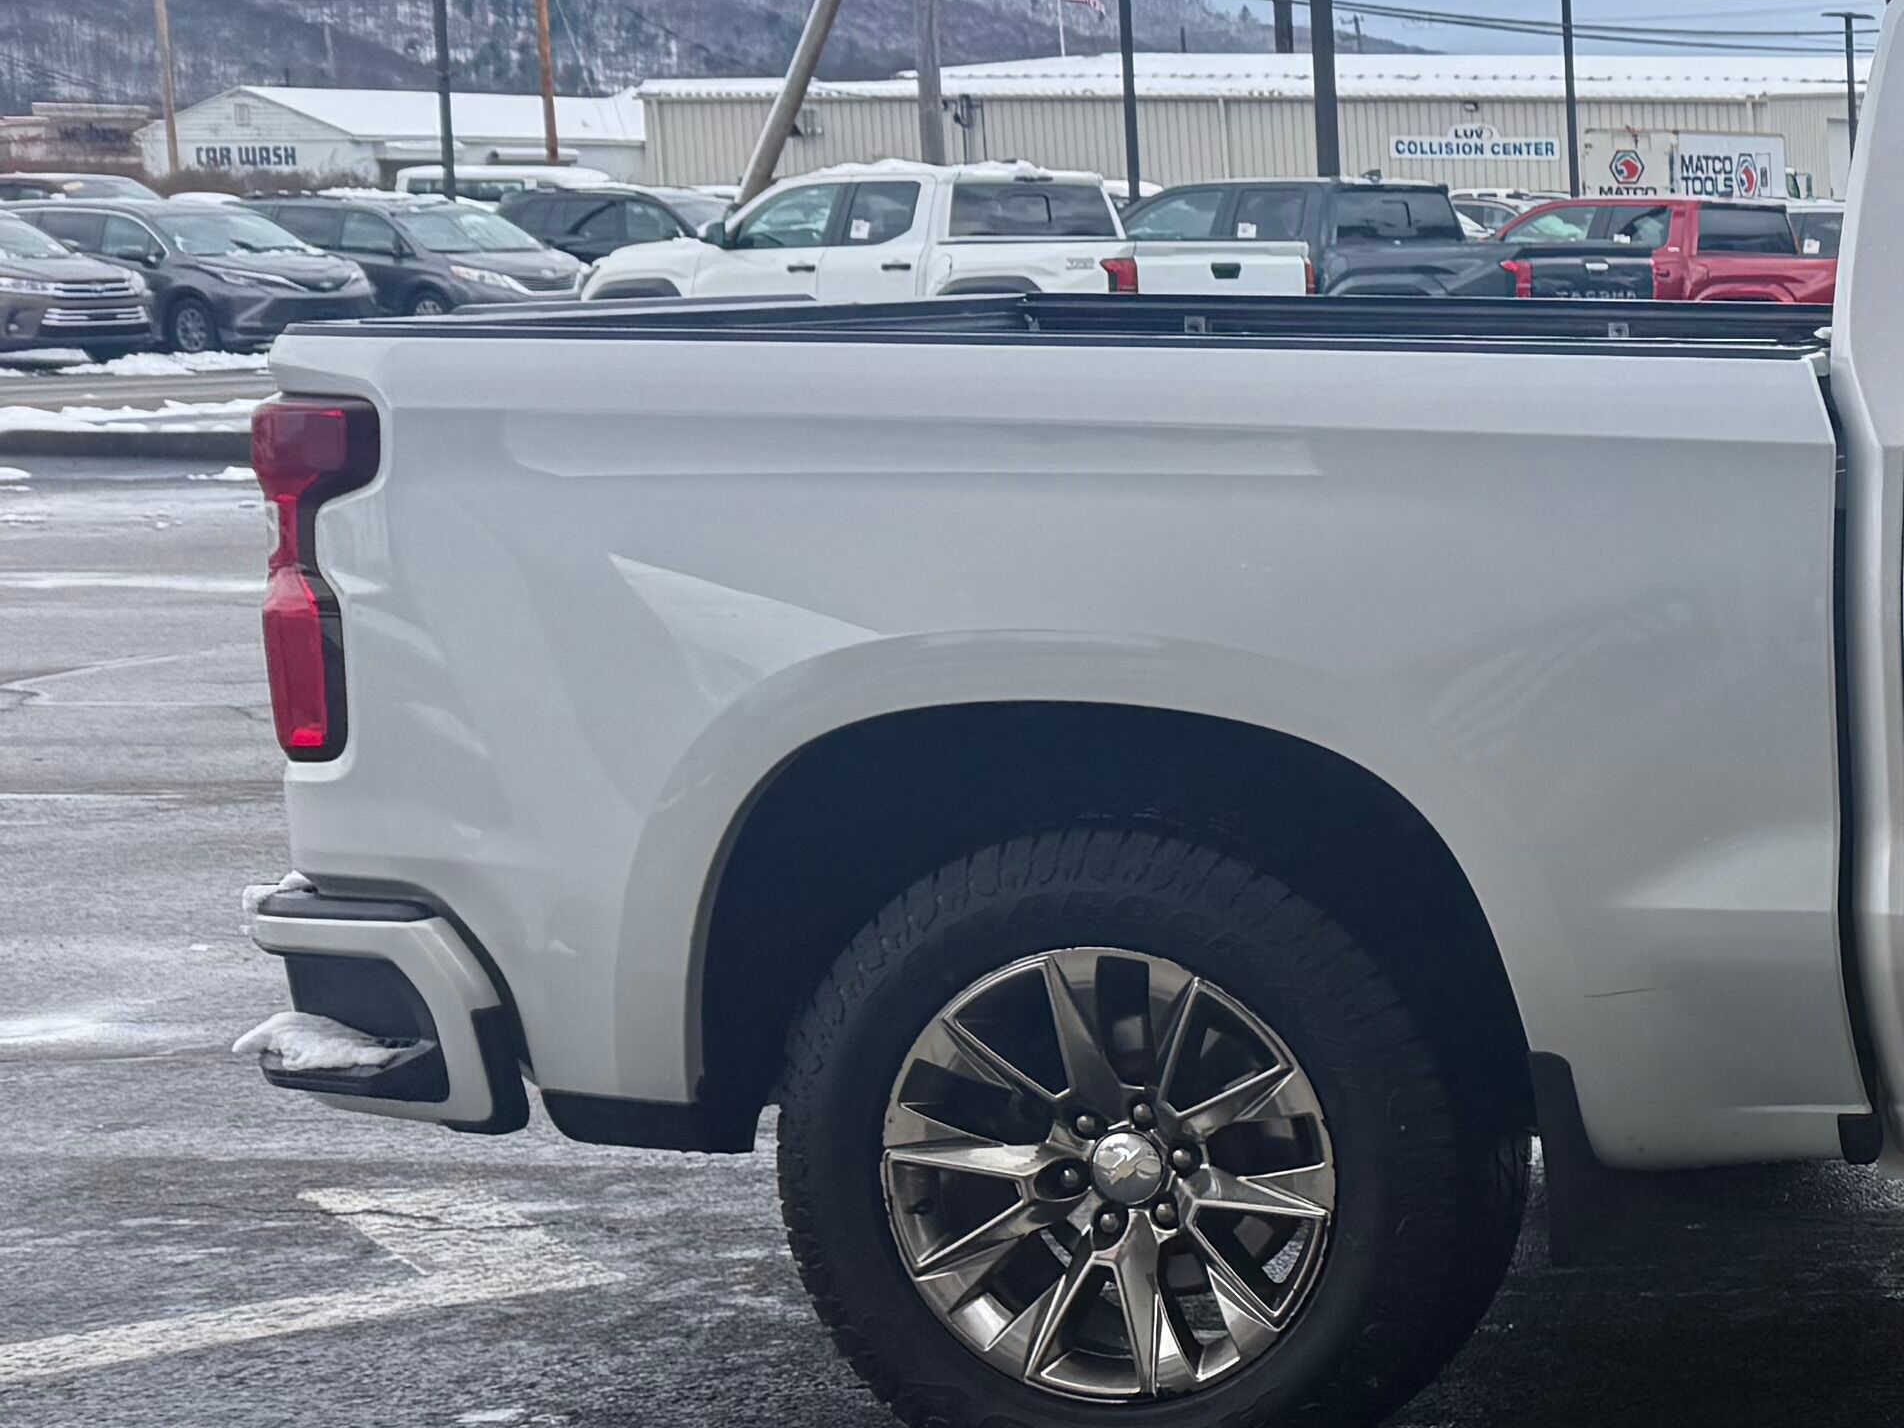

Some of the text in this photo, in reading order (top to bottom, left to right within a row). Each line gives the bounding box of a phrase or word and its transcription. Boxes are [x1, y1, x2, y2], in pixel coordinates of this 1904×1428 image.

[195, 147, 297, 166] CAR WASH
[1395, 140, 1555, 156] COLLISION CENTER
[1680, 154, 1733, 175] MATCO
[1681, 177, 1733, 197] TOOLS
